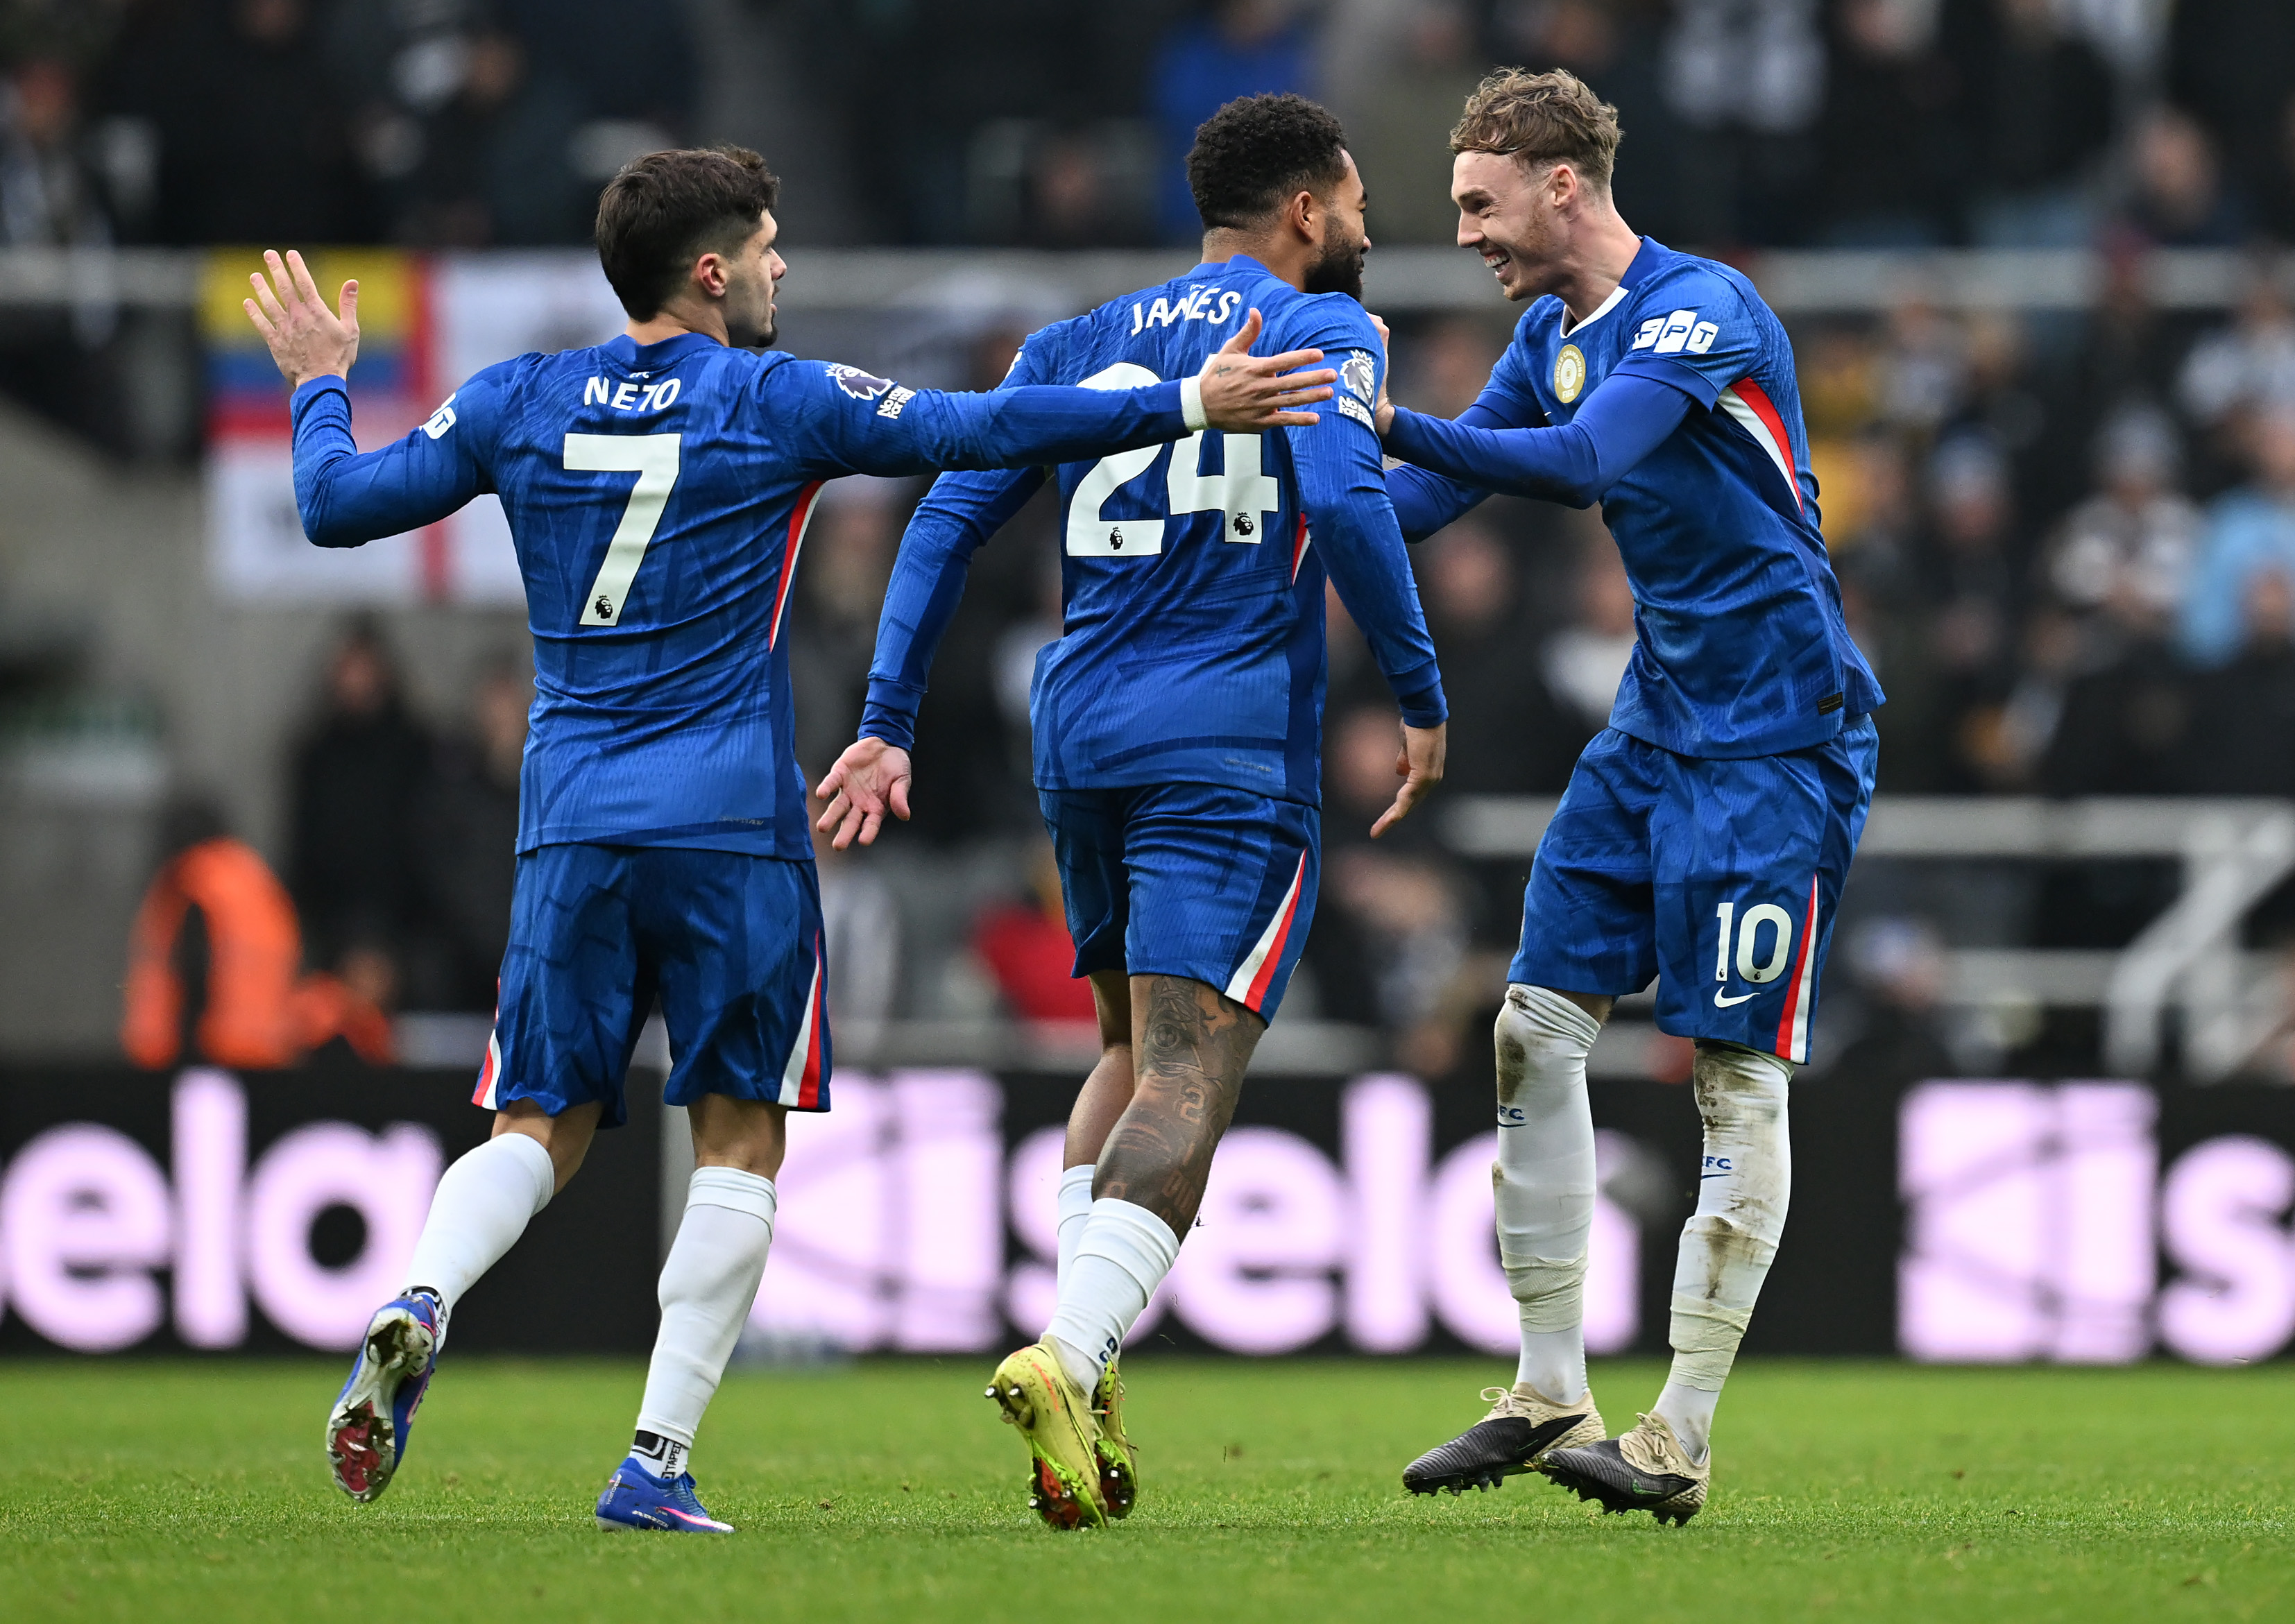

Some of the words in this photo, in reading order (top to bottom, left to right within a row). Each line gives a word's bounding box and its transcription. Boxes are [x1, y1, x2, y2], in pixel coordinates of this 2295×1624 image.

[583, 376, 681, 412] NETO
[1555, 357, 1564, 384] WORLD
[1563, 350, 1582, 377] CHAMPIONS
[1562, 388, 1575, 399] FIFA
[1066, 354, 1278, 556] 24
[563, 433, 681, 626] 7
[1715, 902, 1792, 983] 10
[1702, 1156, 1732, 1170] FC
[0, 1066, 444, 1353] ela
